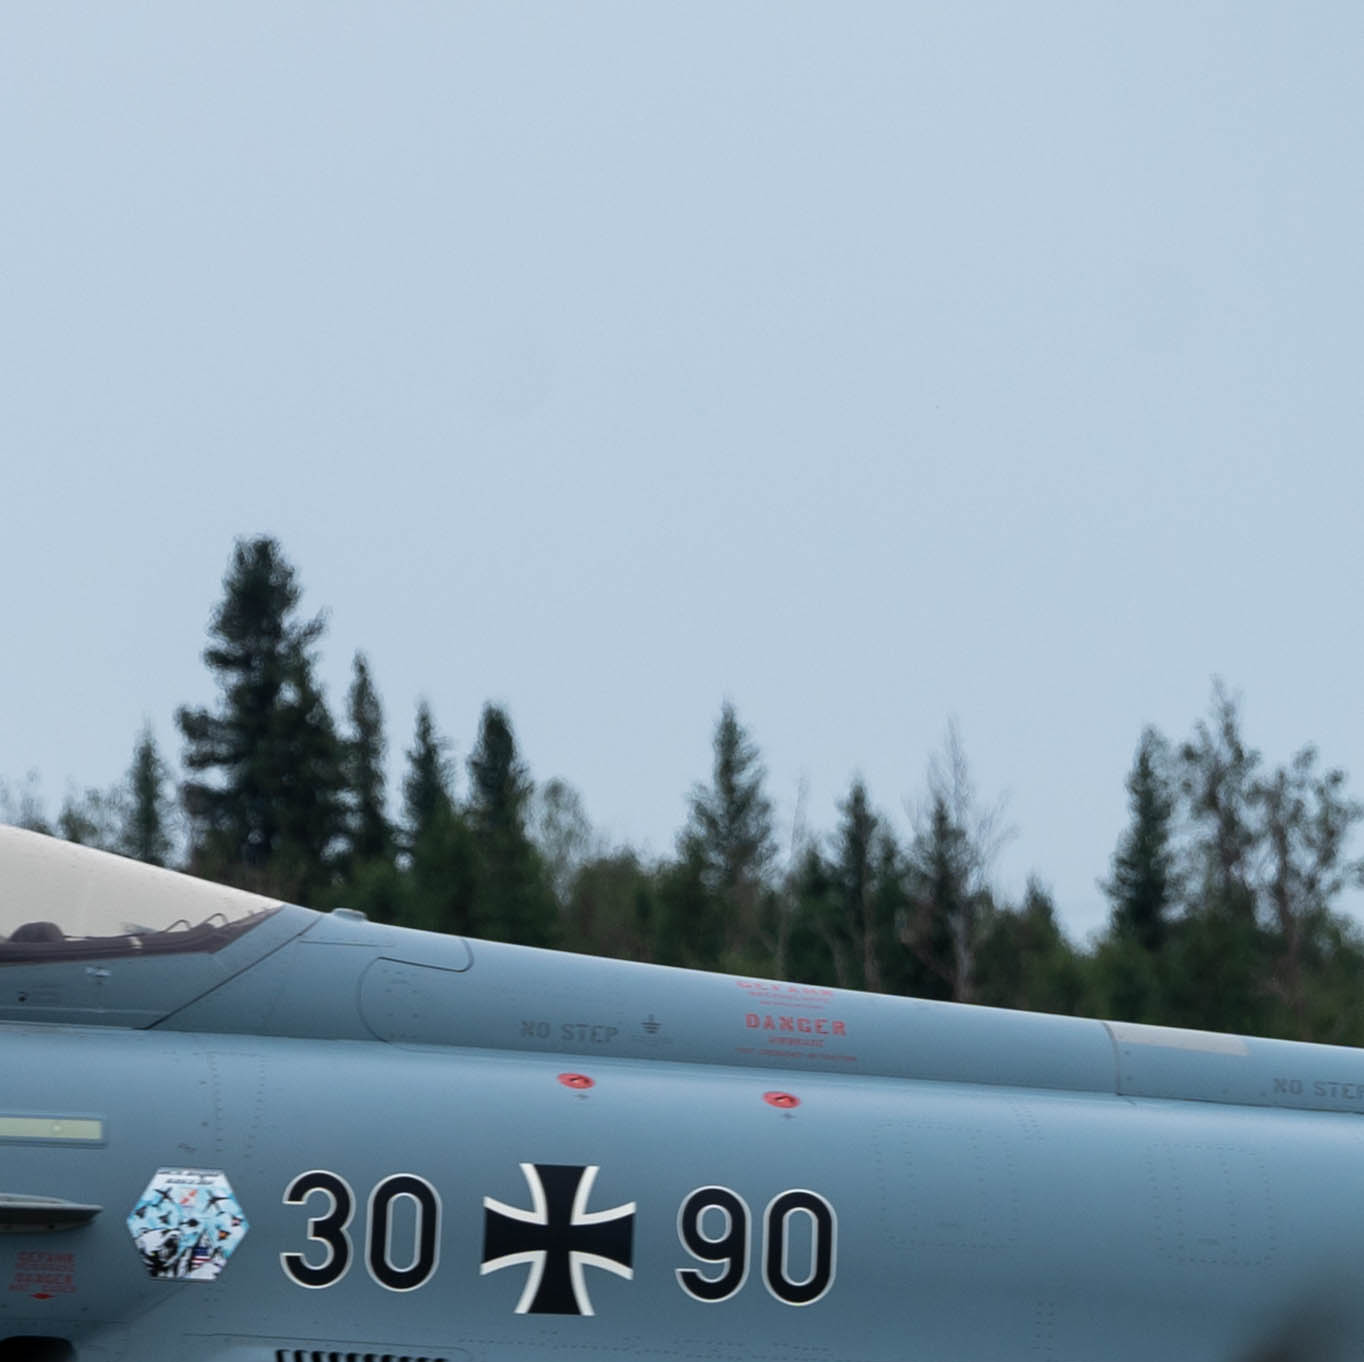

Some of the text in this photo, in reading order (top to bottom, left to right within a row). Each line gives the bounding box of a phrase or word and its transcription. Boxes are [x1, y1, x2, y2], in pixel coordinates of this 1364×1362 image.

[521, 1020, 619, 1043] NO STEP
[744, 1012, 847, 1036] DANGER
[1273, 1078, 1303, 1096] NO
[280, 1169, 442, 1292] 30
[675, 1185, 838, 1307] 90
